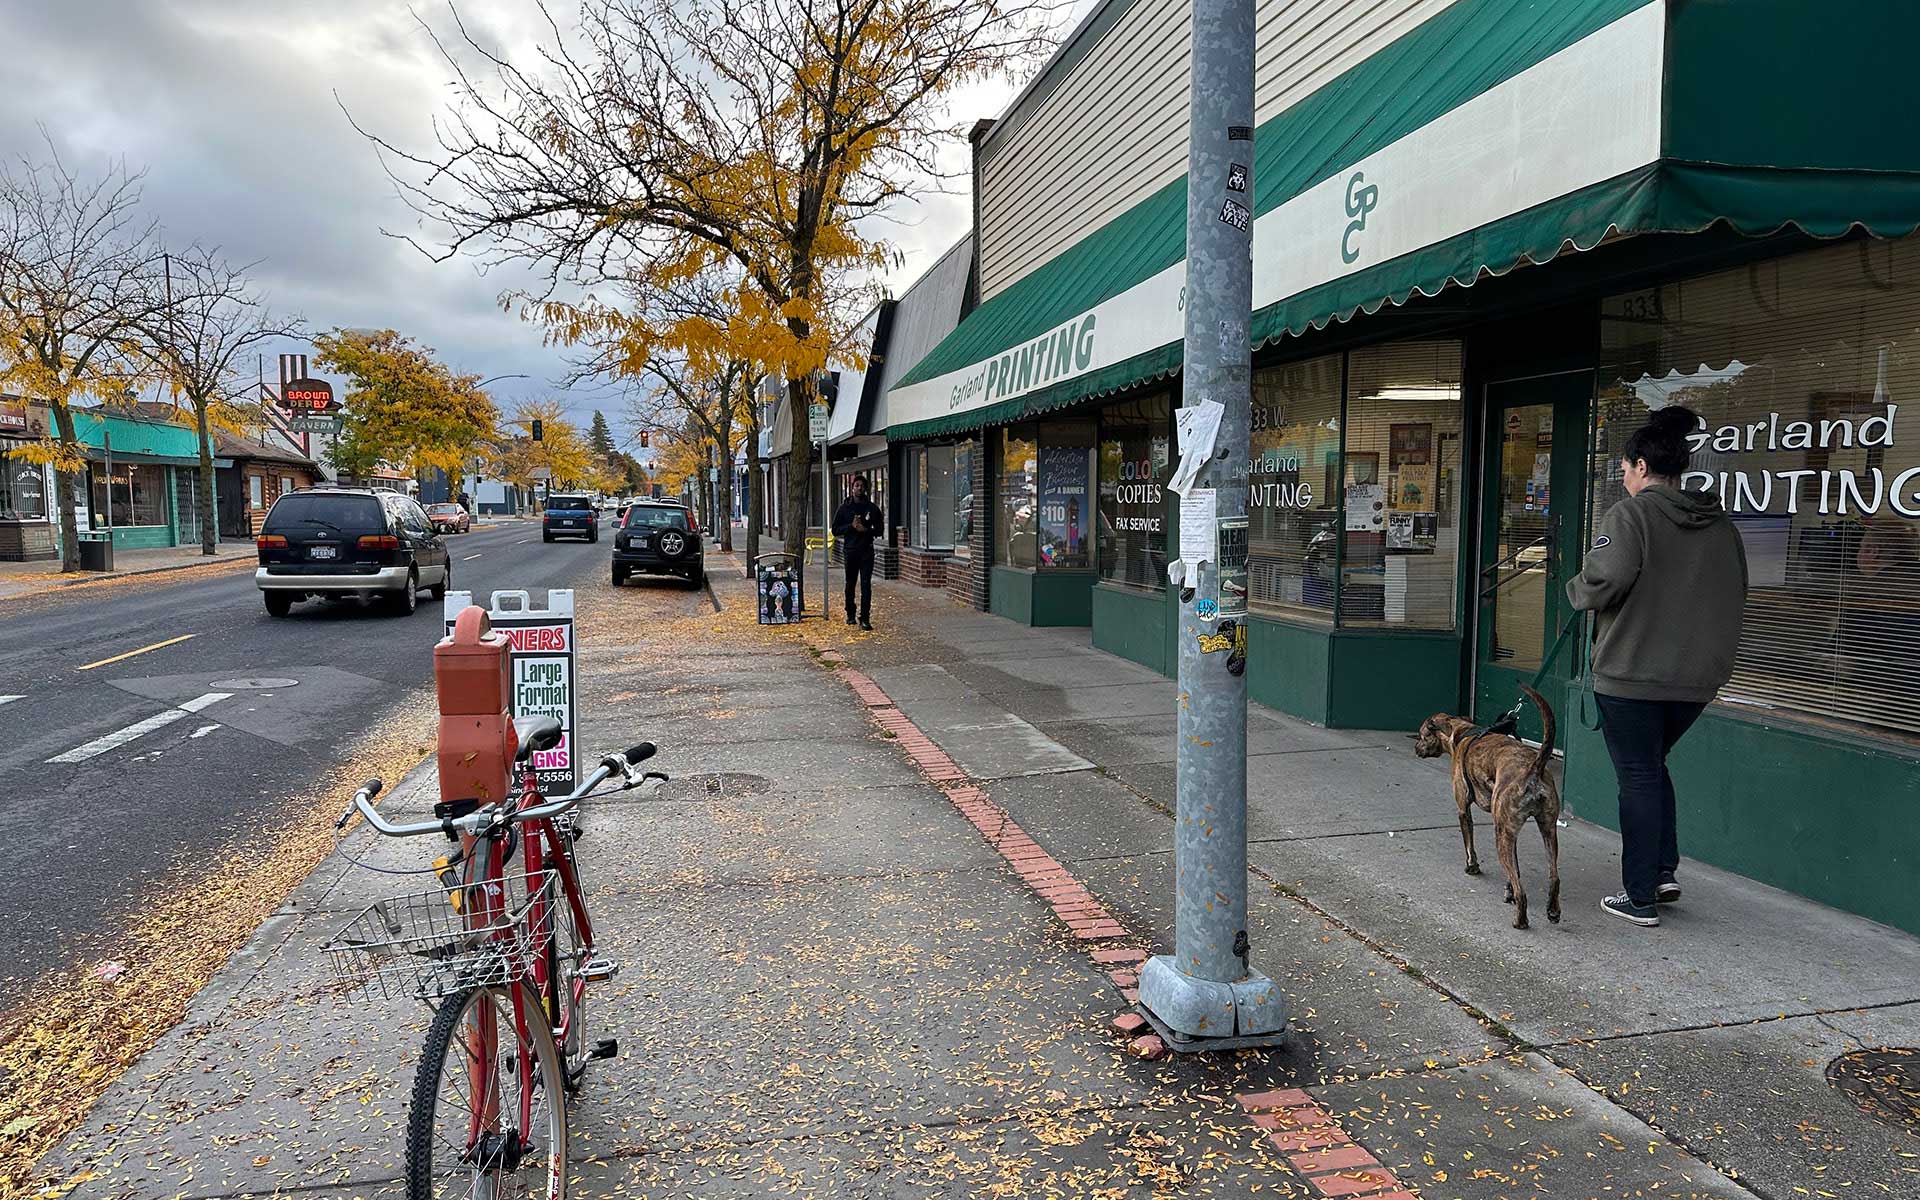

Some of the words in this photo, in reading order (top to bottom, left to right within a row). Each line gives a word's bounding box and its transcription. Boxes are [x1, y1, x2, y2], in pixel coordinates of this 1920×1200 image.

[950, 363, 986, 410] Garland
[984, 313, 1096, 401] PRINTING
[287, 391, 330, 400] BROWN
[290, 400, 329, 409] DERBY
[292, 421, 335, 430] TAVERN
[1119, 460, 1160, 480] COLOR
[1062, 486, 1085, 495] BANNER
[1116, 484, 1162, 504] COPIES
[1041, 505, 1066, 522] $110
[1116, 517, 1129, 530] FAX
[1129, 518, 1160, 532] SERVICE
[507, 628, 566, 651] NERS
[521, 660, 562, 685] Large
[517, 683, 568, 707] Format
